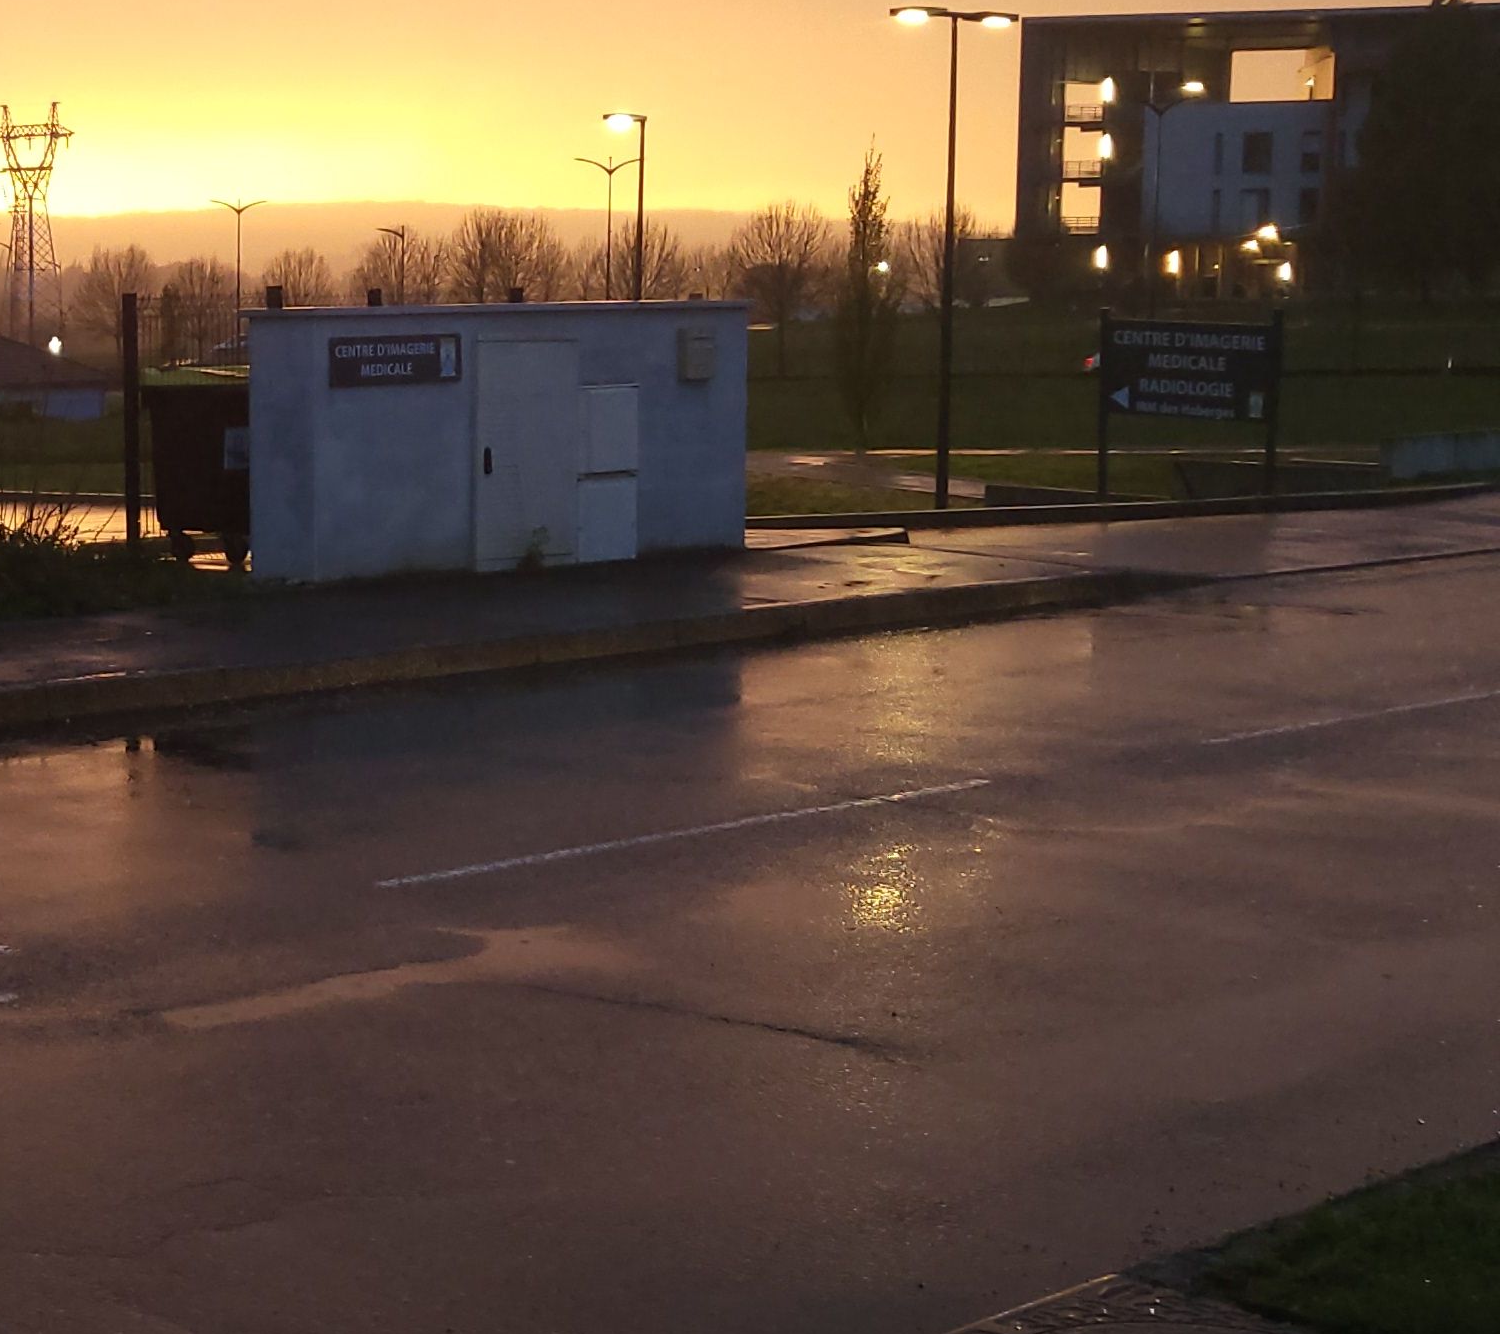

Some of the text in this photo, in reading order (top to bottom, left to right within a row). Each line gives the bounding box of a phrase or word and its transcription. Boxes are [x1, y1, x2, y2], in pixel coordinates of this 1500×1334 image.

[1114, 329, 1266, 351] CENTRE D'IMAGERIE
[334, 342, 436, 358] CENTRE D'IMAGERIE
[361, 363, 413, 377] MEDICALE
[1148, 353, 1227, 371] MEDICALE
[1139, 378, 1234, 398] RADIOLOGIE
